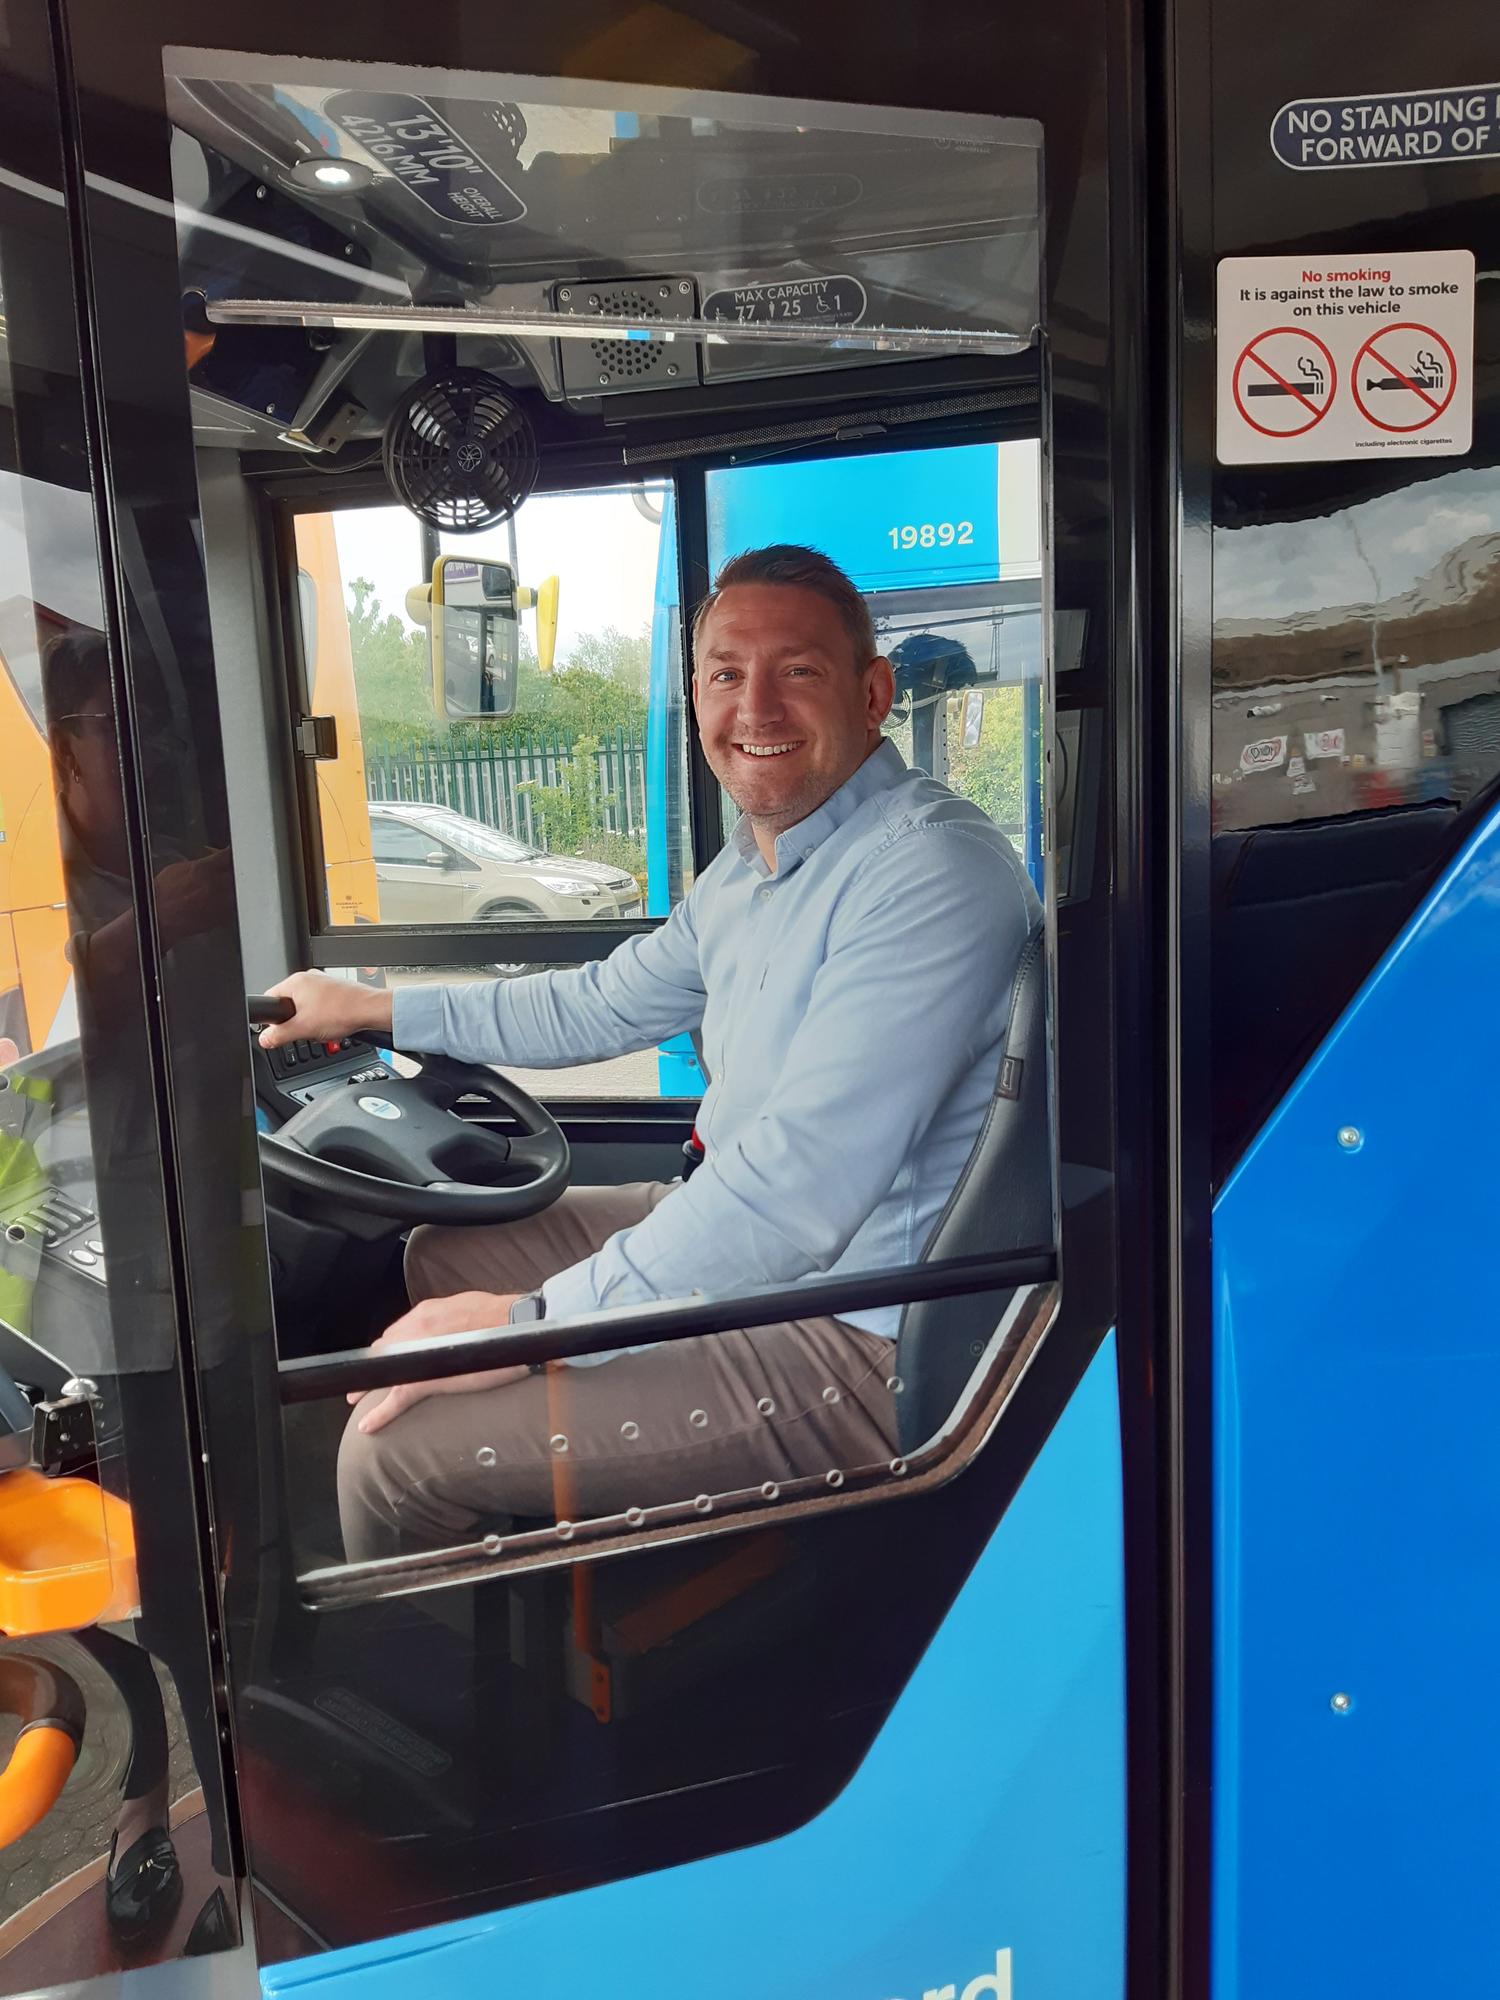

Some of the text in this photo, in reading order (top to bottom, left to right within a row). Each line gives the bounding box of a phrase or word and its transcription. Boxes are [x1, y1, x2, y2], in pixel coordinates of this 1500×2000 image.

[1288, 109, 1332, 134] NO
[1341, 96, 1486, 131] STANDING
[1302, 126, 1491, 162] FORWARD OF
[447, 192, 484, 217] HEIGHT
[463, 187, 503, 219] OVERALL
[1302, 268, 1391, 283] No smoking
[734, 281, 829, 304] MAX CAPACITY
[1240, 282, 1459, 303] It is against the law to smoke
[735, 305, 756, 320] 77
[781, 301, 801, 317] 25
[833, 295, 841, 311] 1
[1293, 301, 1401, 317] on this vehicle
[1420, 438, 1453, 446] cigarettes
[888, 521, 974, 550] 19892
